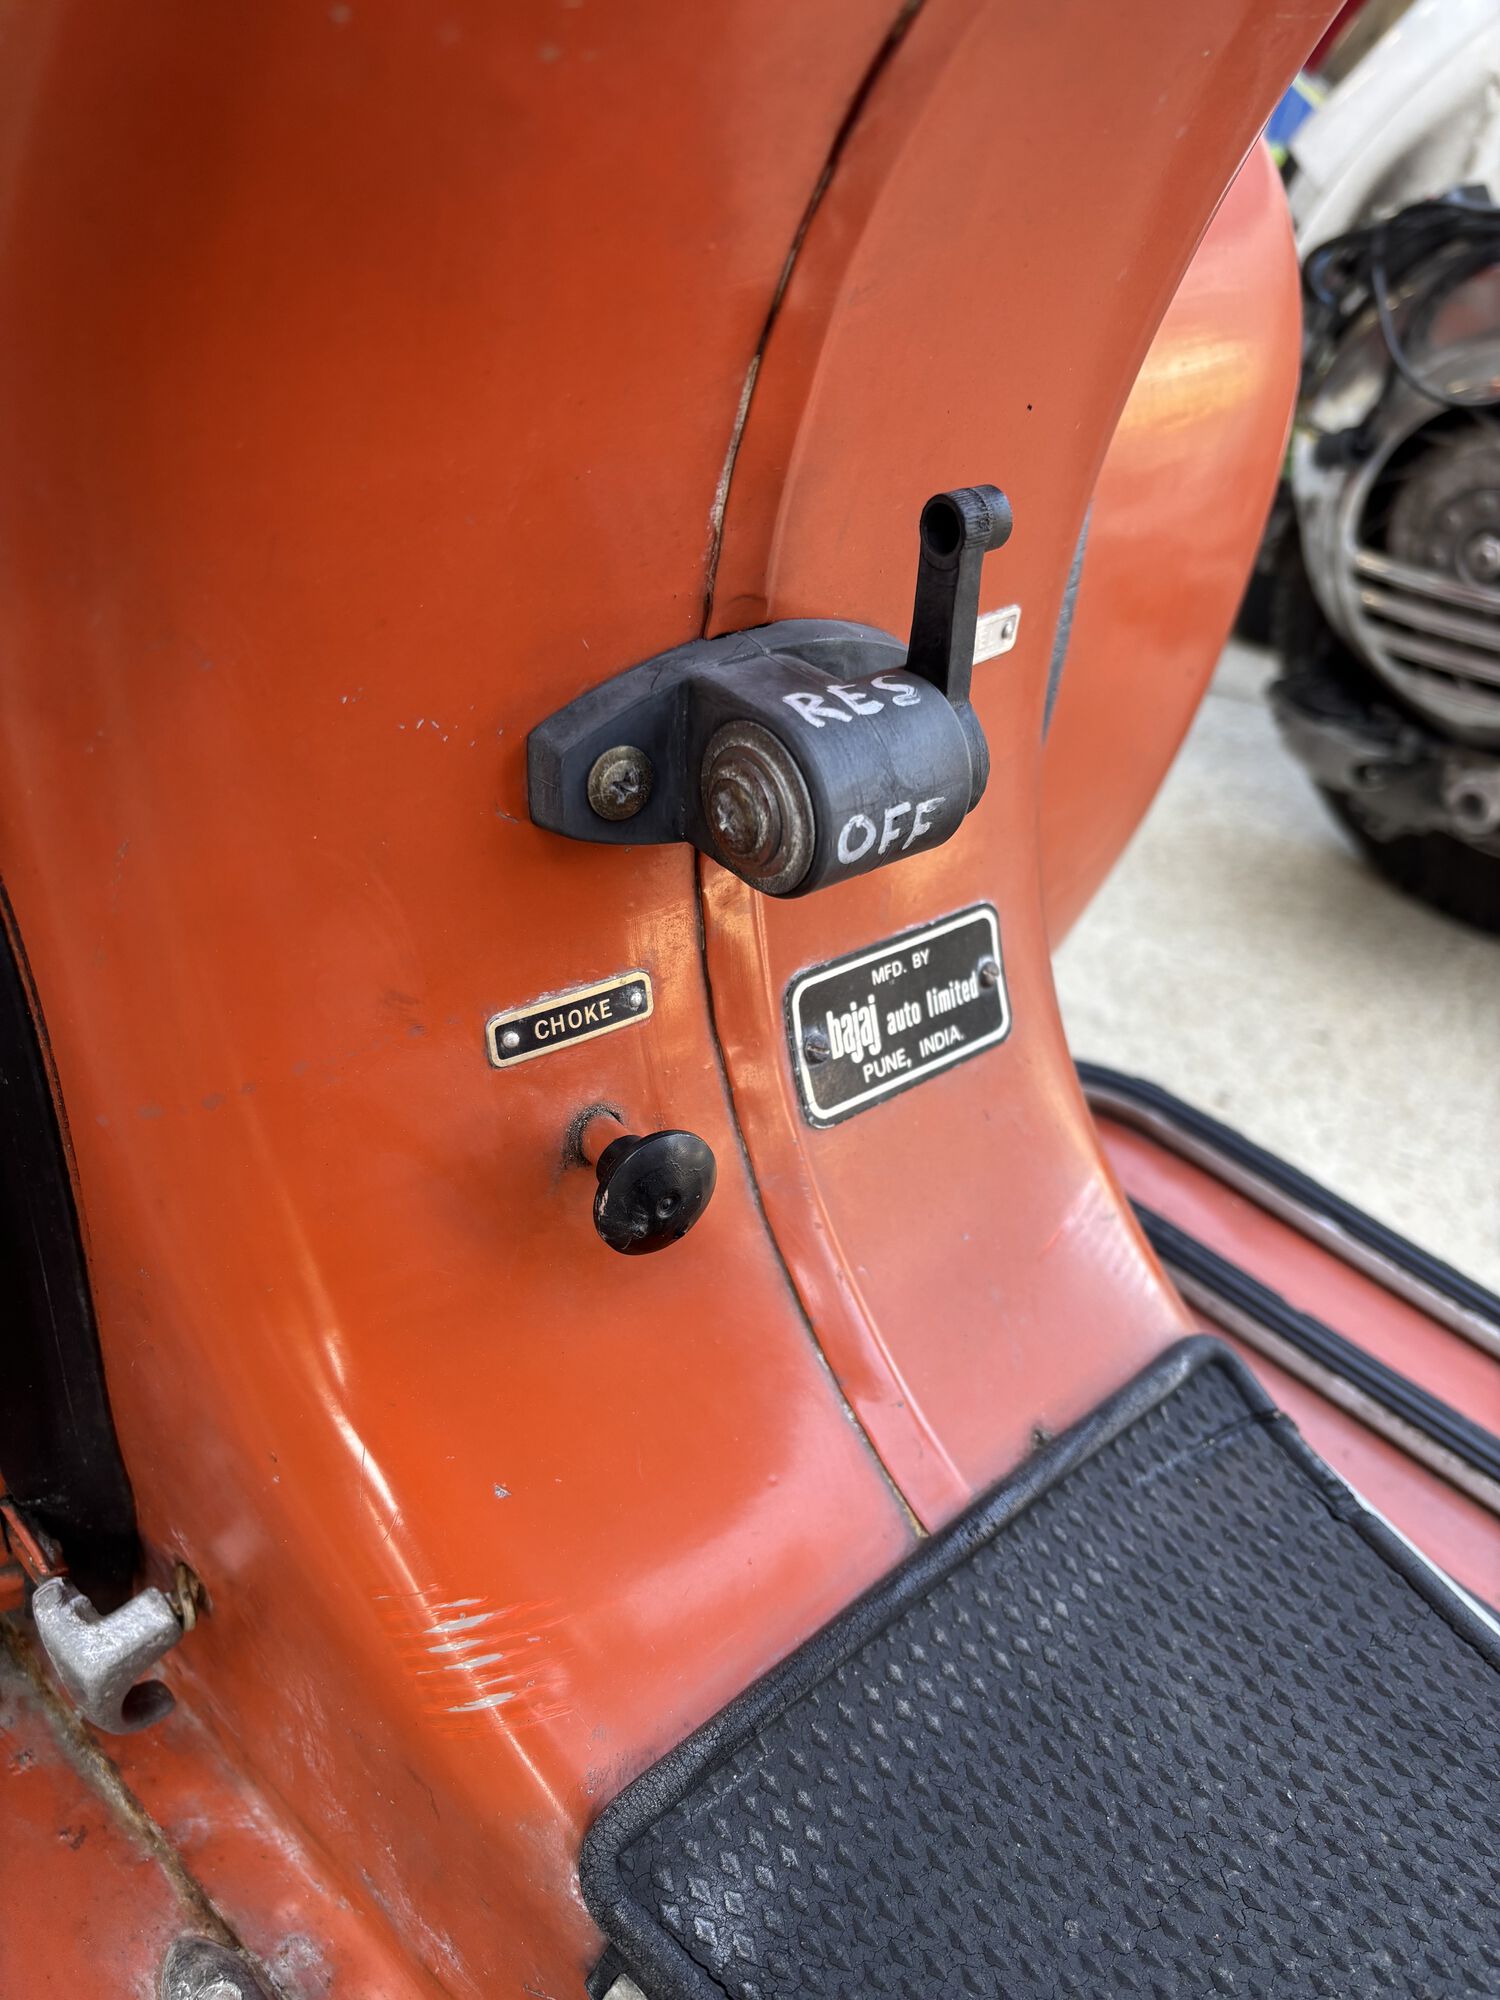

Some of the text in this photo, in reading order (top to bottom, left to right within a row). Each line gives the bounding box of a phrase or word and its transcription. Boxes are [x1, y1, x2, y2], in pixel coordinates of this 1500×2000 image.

[782, 675, 921, 728] RES
[837, 796, 946, 864] OFF
[871, 949, 931, 986] MFD. BY
[534, 998, 613, 1040] CHOKE
[825, 971, 980, 1064] bajaj auto limited
[862, 1024, 965, 1083] PUNE, INDIA.
